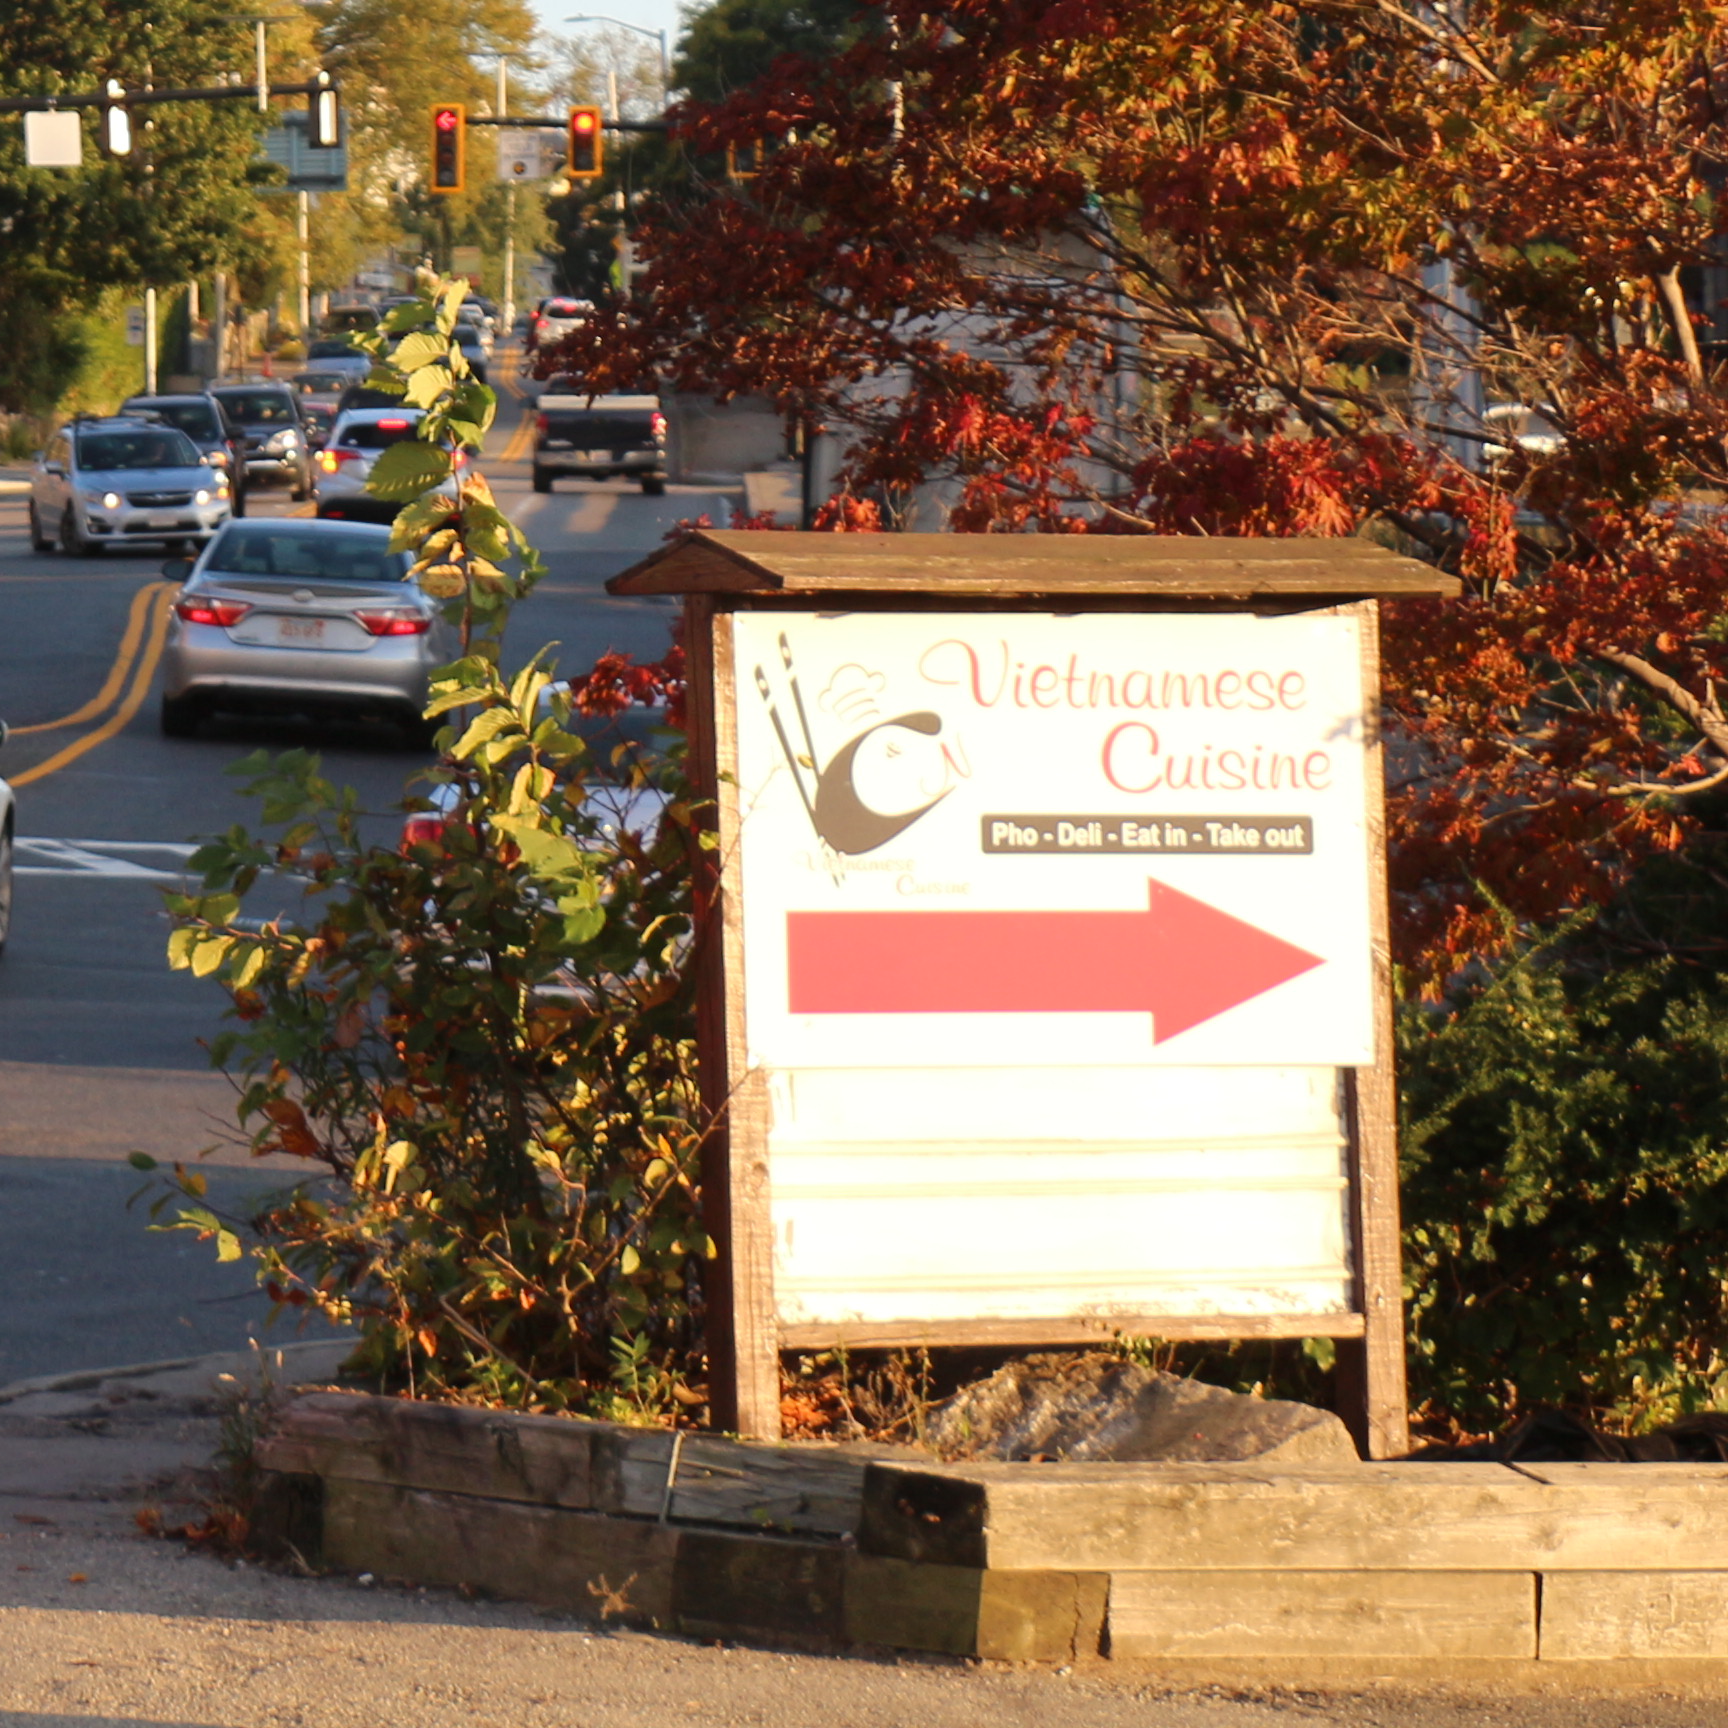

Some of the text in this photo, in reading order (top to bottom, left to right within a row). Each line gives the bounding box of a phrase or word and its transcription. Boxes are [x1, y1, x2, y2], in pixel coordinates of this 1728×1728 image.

[919, 639, 1308, 711] Vietnamese
[1101, 721, 1334, 794] Cuisine
[991, 821, 1305, 847] Pho Deli Eat in Take out
